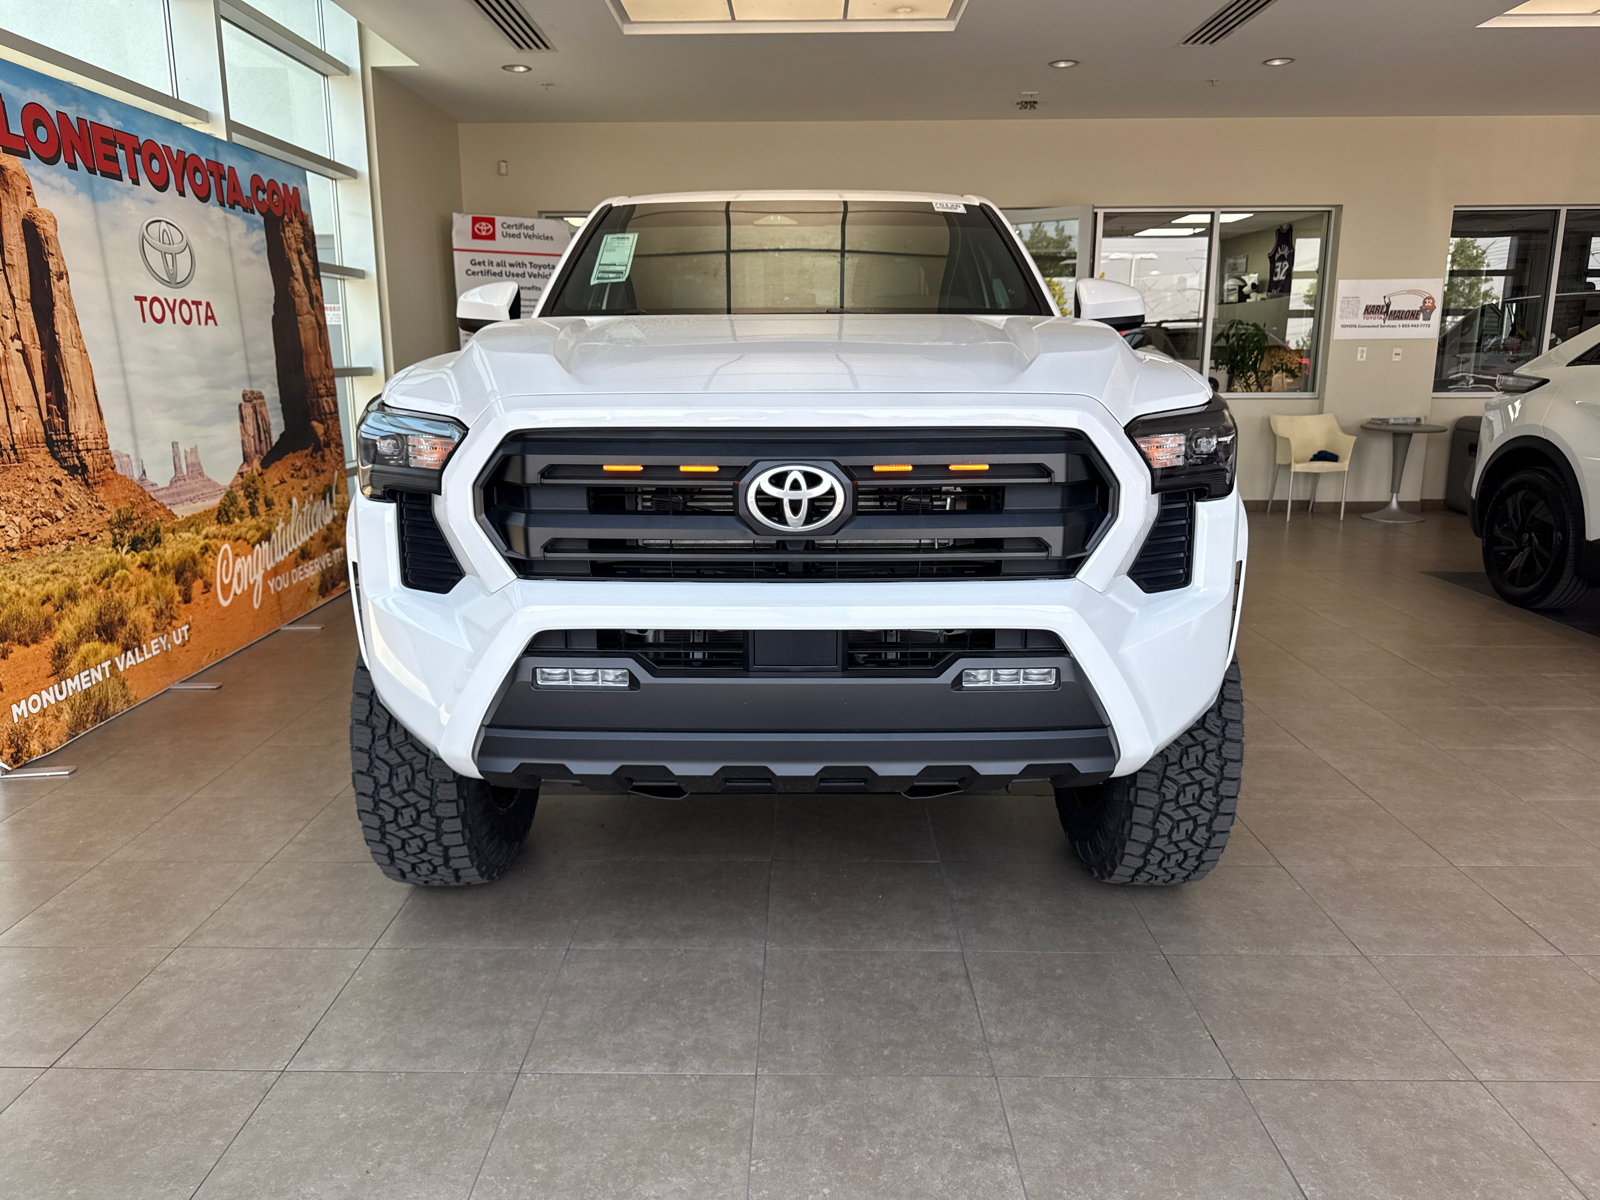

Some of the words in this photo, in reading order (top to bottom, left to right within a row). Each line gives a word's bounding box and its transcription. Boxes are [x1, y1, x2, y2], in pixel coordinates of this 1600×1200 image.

[501, 222, 535, 231] Certified
[501, 231, 521, 239] Used
[522, 232, 554, 241] Vehicles
[470, 259, 486, 267] Get
[487, 259, 494, 267] it
[496, 260, 507, 268] all
[508, 261, 527, 269] with
[528, 261, 556, 271] Toyota
[1273, 261, 1290, 281] 32
[465, 268, 503, 278] Certified
[505, 270, 526, 279] Used
[527, 271, 552, 280] Vehicl
[1424, 299, 1432, 307] 32
[134, 294, 218, 327] TOYOTA
[1363, 305, 1386, 315] KARL
[1388, 310, 1421, 320] MALONE
[216, 469, 338, 610] Congratulations!
[267, 570, 290, 595] YOU
[290, 552, 334, 584] DESERVE
[332, 547, 344, 567] IT!
[11, 660, 112, 724] MONUMENT
[114, 634, 172, 673] VALLEY,
[172, 624, 190, 645] UT
